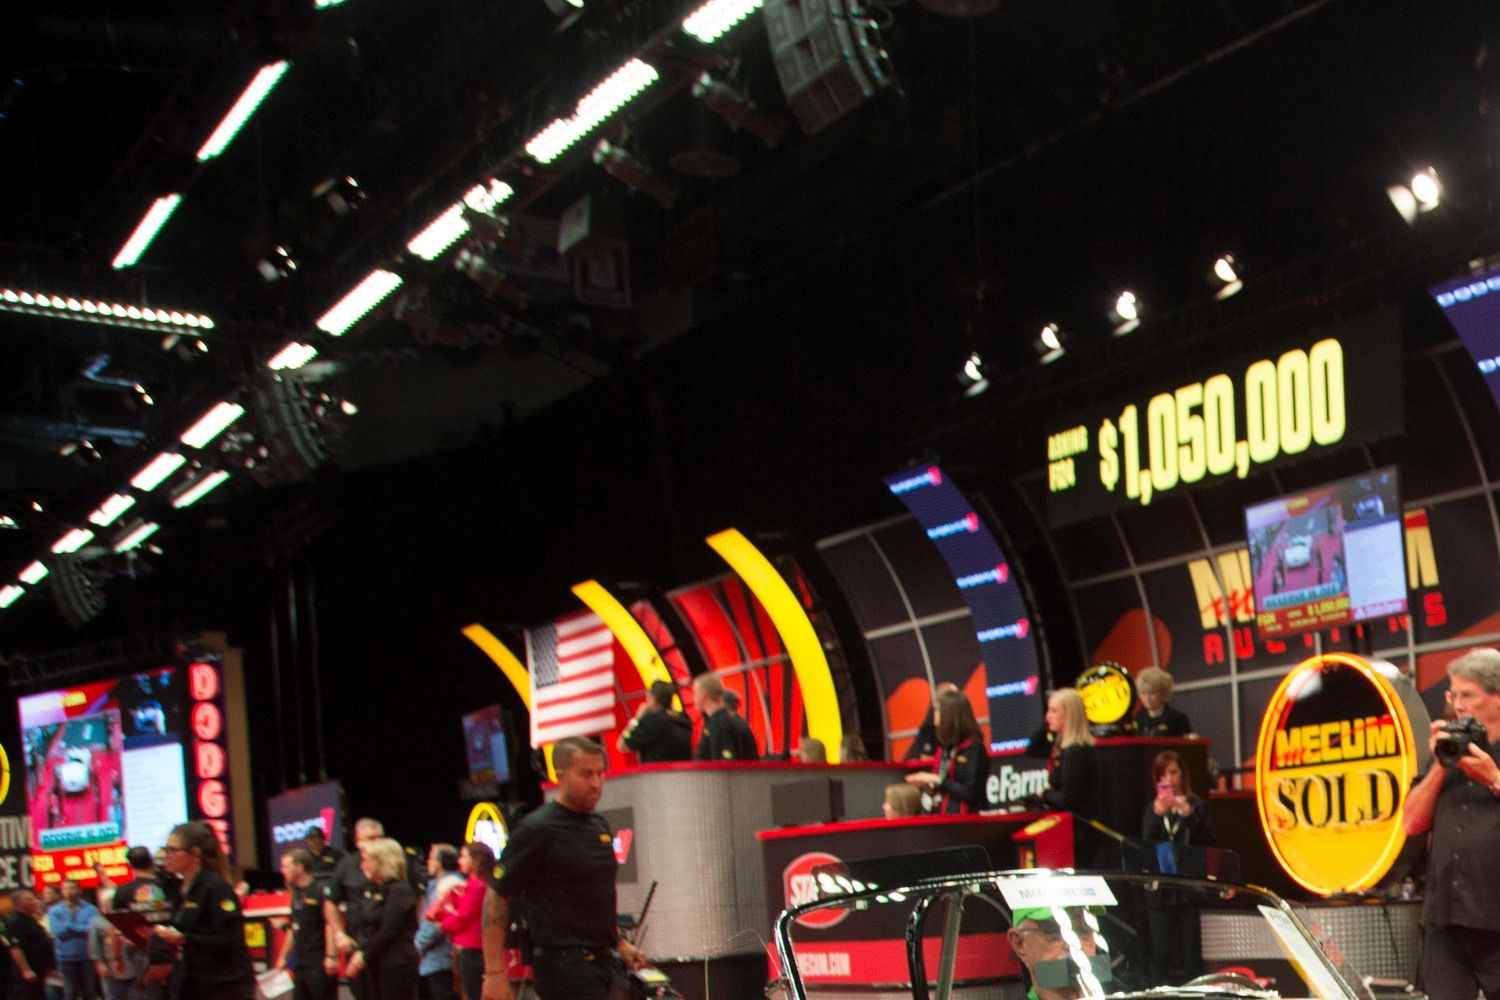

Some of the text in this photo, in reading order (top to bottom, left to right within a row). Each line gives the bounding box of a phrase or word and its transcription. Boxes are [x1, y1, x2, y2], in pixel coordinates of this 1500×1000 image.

[1099, 338, 1346, 506] $1,050,000
[1276, 714, 1397, 769] MECUM
[1270, 768, 1400, 832] SOLD
